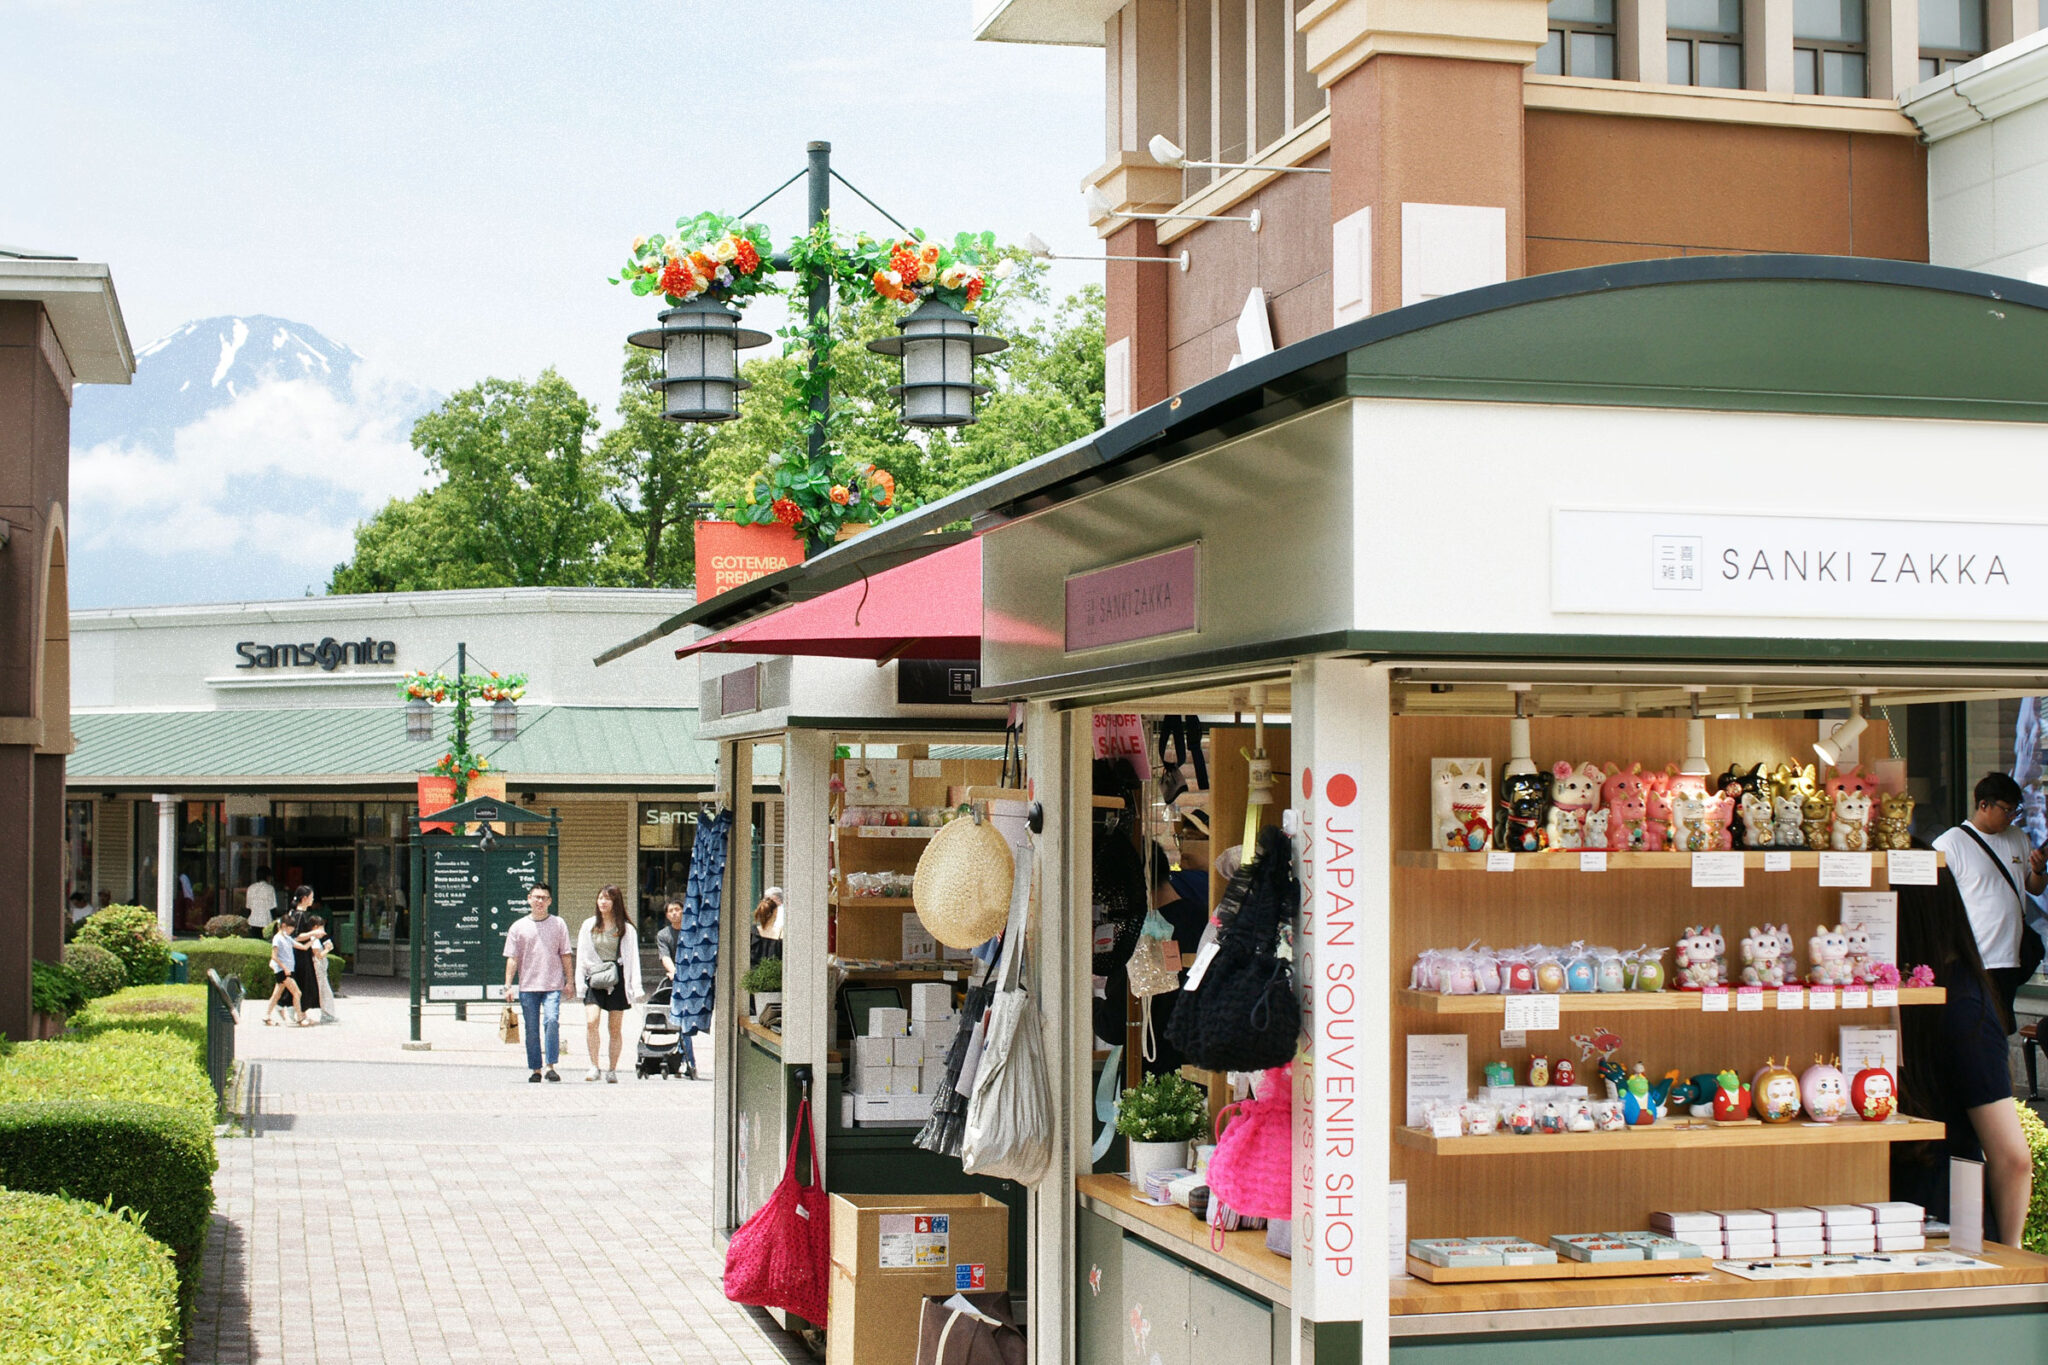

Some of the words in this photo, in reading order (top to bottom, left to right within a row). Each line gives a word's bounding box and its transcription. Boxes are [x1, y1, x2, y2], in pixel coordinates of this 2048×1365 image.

[711, 556, 789, 570] GOTEMBA
[1721, 548, 1851, 582] SANKI
[1870, 551, 2010, 586] ZAKKA
[1100, 591, 1132, 623] SANKI
[1134, 582, 1173, 616] ZAKKA
[236, 637, 396, 671] Samsonite
[1098, 735, 1141, 756] SALE
[646, 809, 698, 825] Sams
[1302, 809, 1314, 936] JAPAN
[1325, 817, 1356, 946] JAPAN
[1325, 963, 1355, 1158] SOUVENIR
[1325, 1173, 1354, 1277] SHOP
